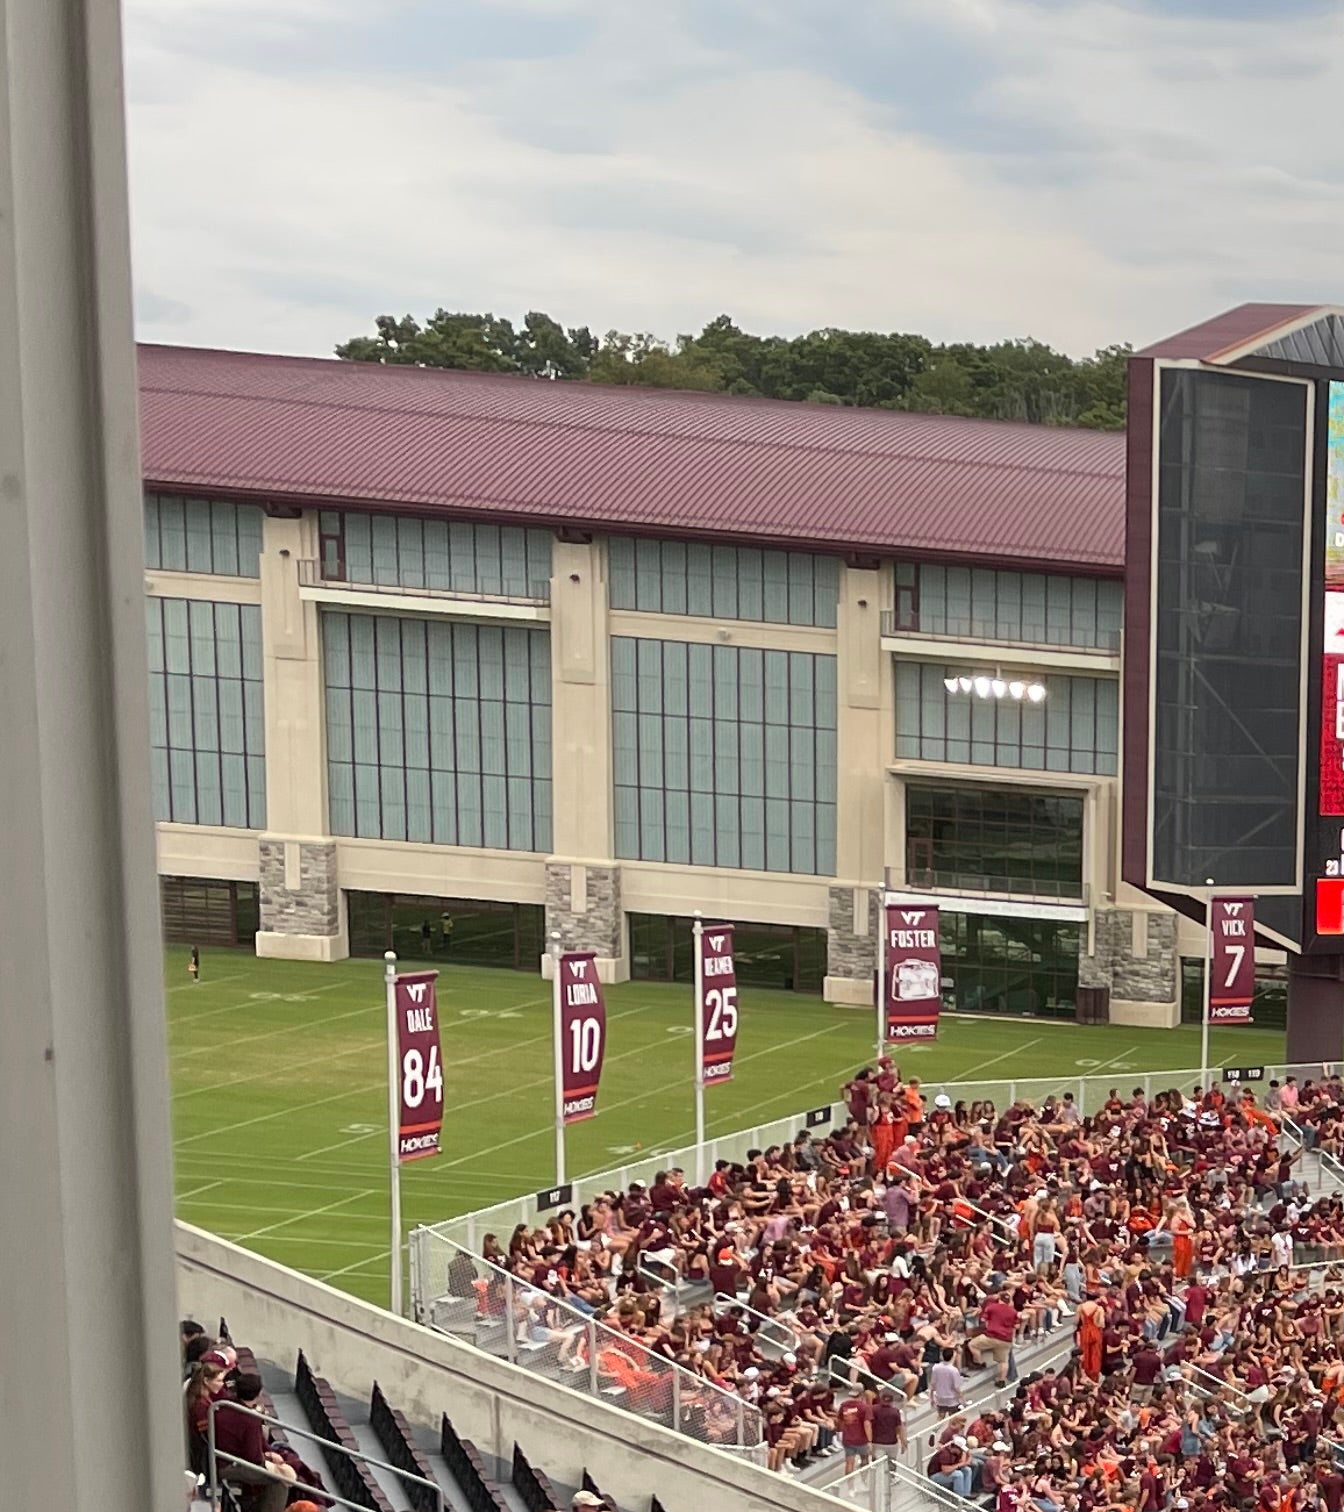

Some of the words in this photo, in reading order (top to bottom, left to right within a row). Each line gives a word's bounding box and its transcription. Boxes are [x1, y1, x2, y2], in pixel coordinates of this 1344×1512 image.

[1326, 860, 1338, 876] 23
[901, 911, 926, 926] VT
[1223, 902, 1244, 917] VT
[1221, 920, 1246, 937] VICK
[708, 935, 725, 952] VT
[891, 929, 936, 948] FOSTER
[569, 961, 588, 979] VT
[1224, 945, 1245, 988] 7
[407, 983, 427, 1002] VT
[406, 1008, 434, 1032] DALE
[705, 987, 738, 1041] 25
[570, 1017, 601, 1073] 10
[403, 1045, 443, 1108] 84
